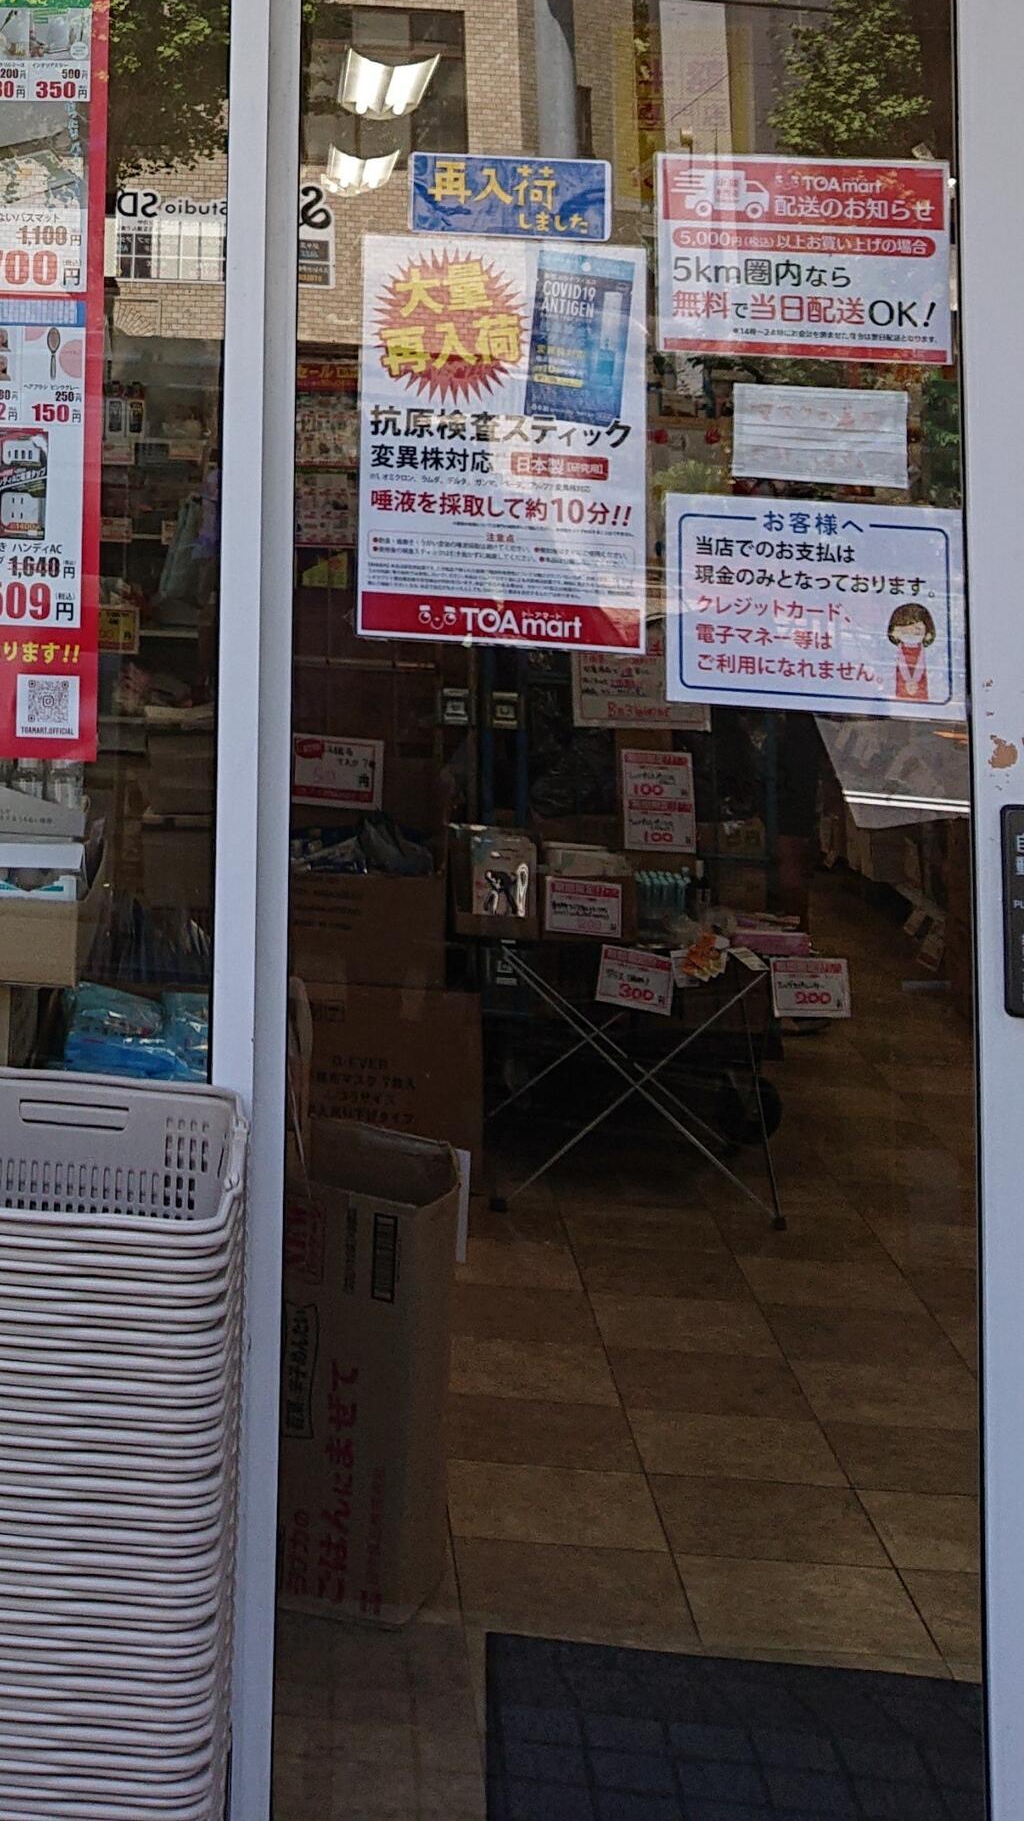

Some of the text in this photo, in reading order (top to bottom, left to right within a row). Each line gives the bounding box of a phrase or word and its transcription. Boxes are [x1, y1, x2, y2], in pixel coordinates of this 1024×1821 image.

[427, 161, 556, 210] 再入荷
[518, 212, 589, 234] しました
[774, 194, 935, 223] 配送のお知らせ
[394, 259, 494, 318] 大量
[370, 405, 633, 449] 抗原検査スティック
[371, 445, 494, 474] 変異株対応
[763, 510, 863, 535] お客様へ
[694, 535, 856, 564] 当店でのお支払は
[694, 564, 937, 599] 現金のみとなっております。
[695, 623, 833, 651] 電子マネー等は
